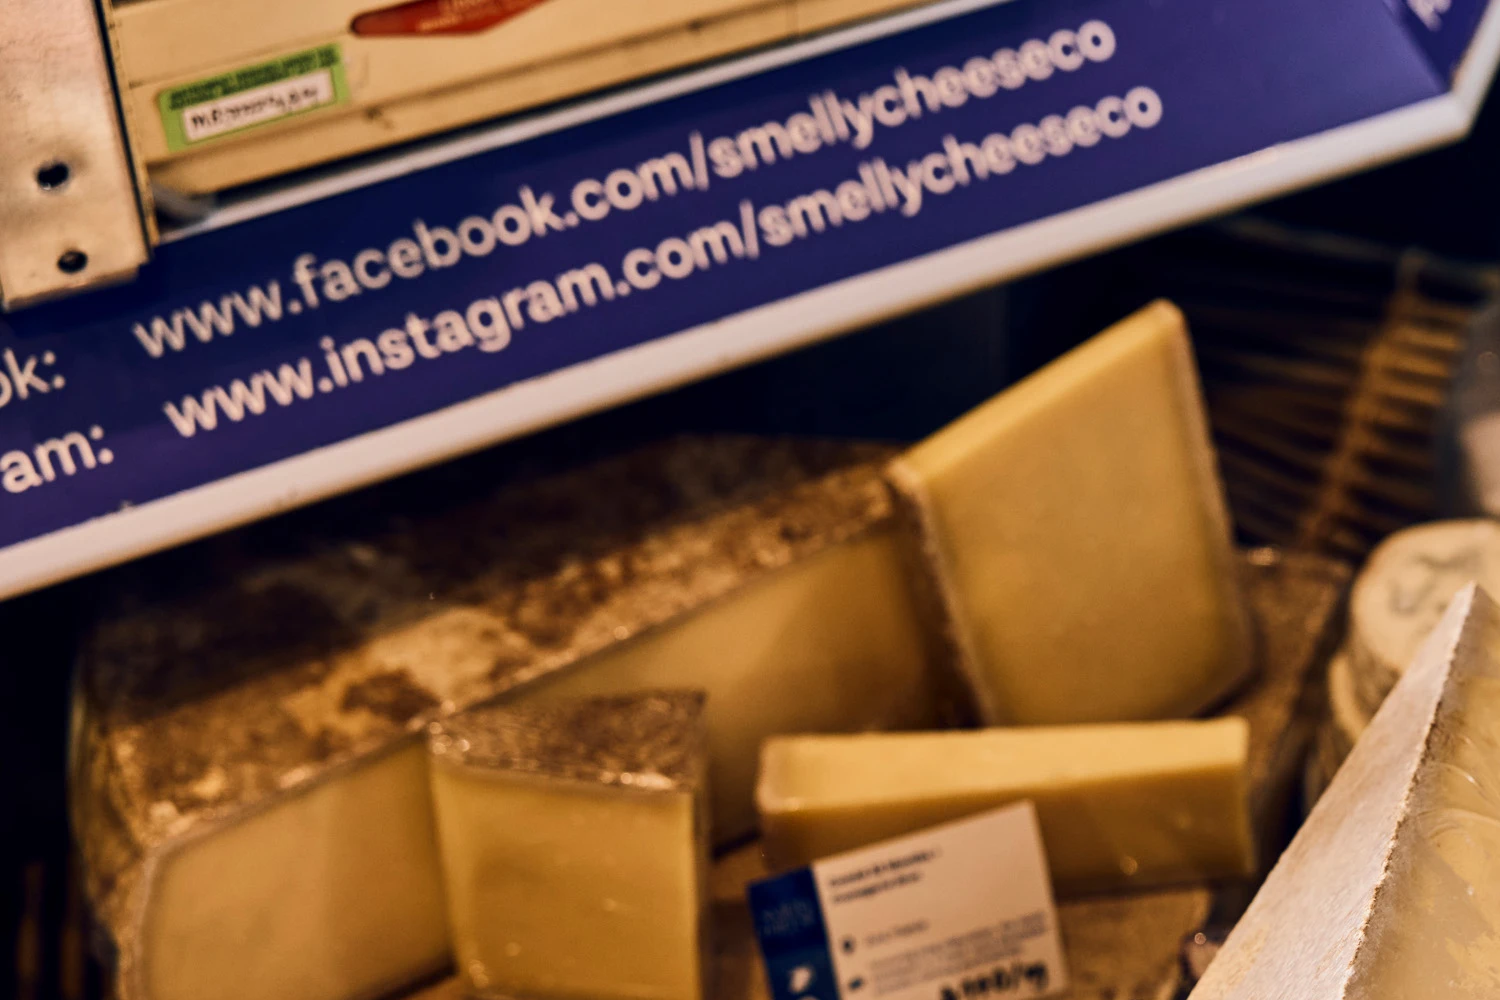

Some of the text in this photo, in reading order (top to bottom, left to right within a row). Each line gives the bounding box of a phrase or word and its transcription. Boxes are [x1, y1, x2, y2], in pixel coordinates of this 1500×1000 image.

[0, 86, 1163, 493] am: www.instagram.com/smellycheeseco
[134, 19, 1117, 358] www.facebook.com/smellycheeseco
